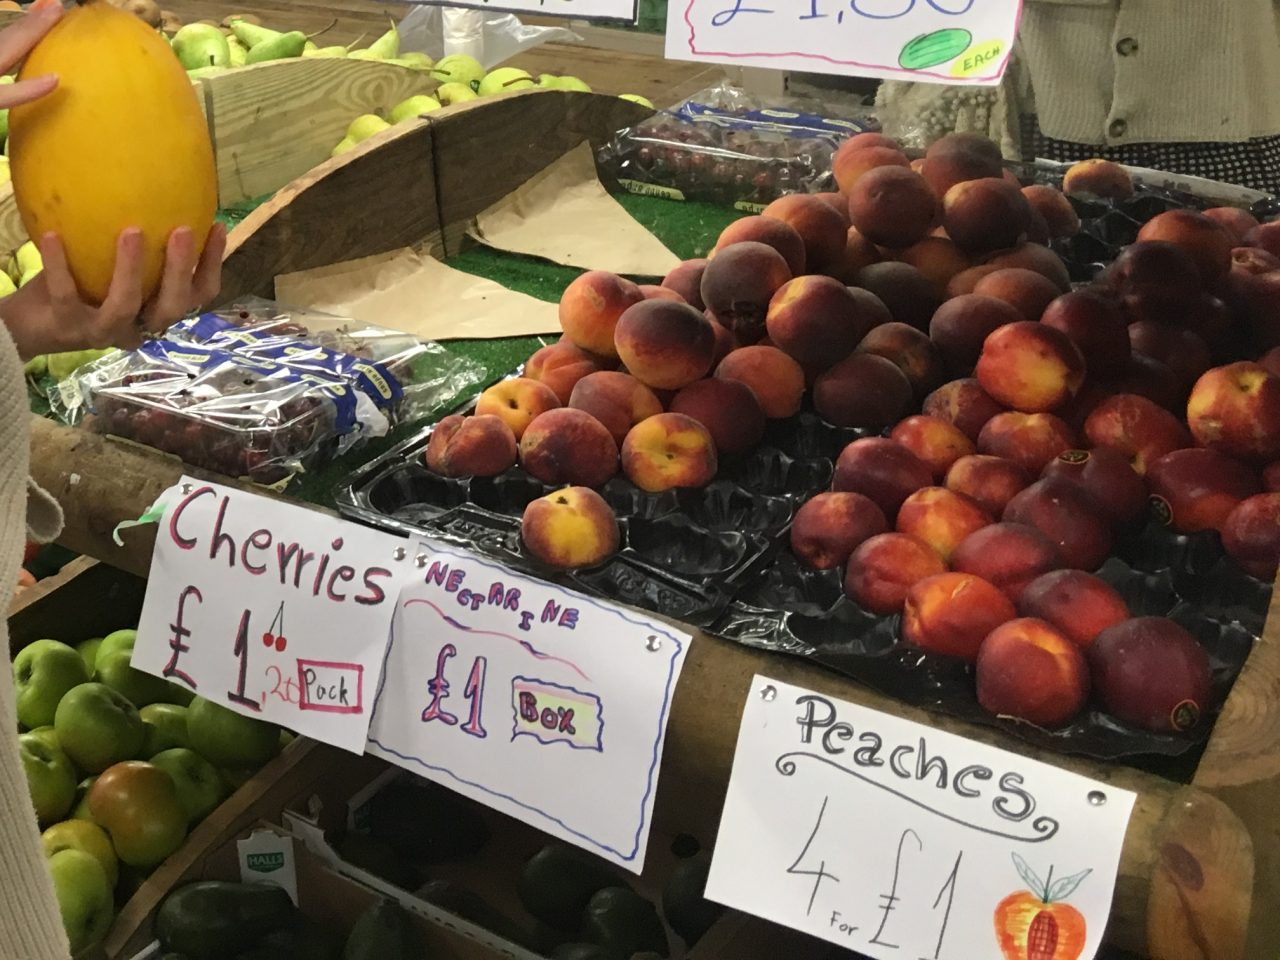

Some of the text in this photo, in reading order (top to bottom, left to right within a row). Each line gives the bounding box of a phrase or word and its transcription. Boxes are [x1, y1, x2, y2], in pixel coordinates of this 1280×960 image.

[962, 44, 1002, 73] EACH
[170, 486, 393, 606] Cherries
[421, 643, 488, 739] £1
[795, 695, 1037, 823] Peaches
[786, 796, 841, 917] 4
[868, 828, 964, 960] £1
